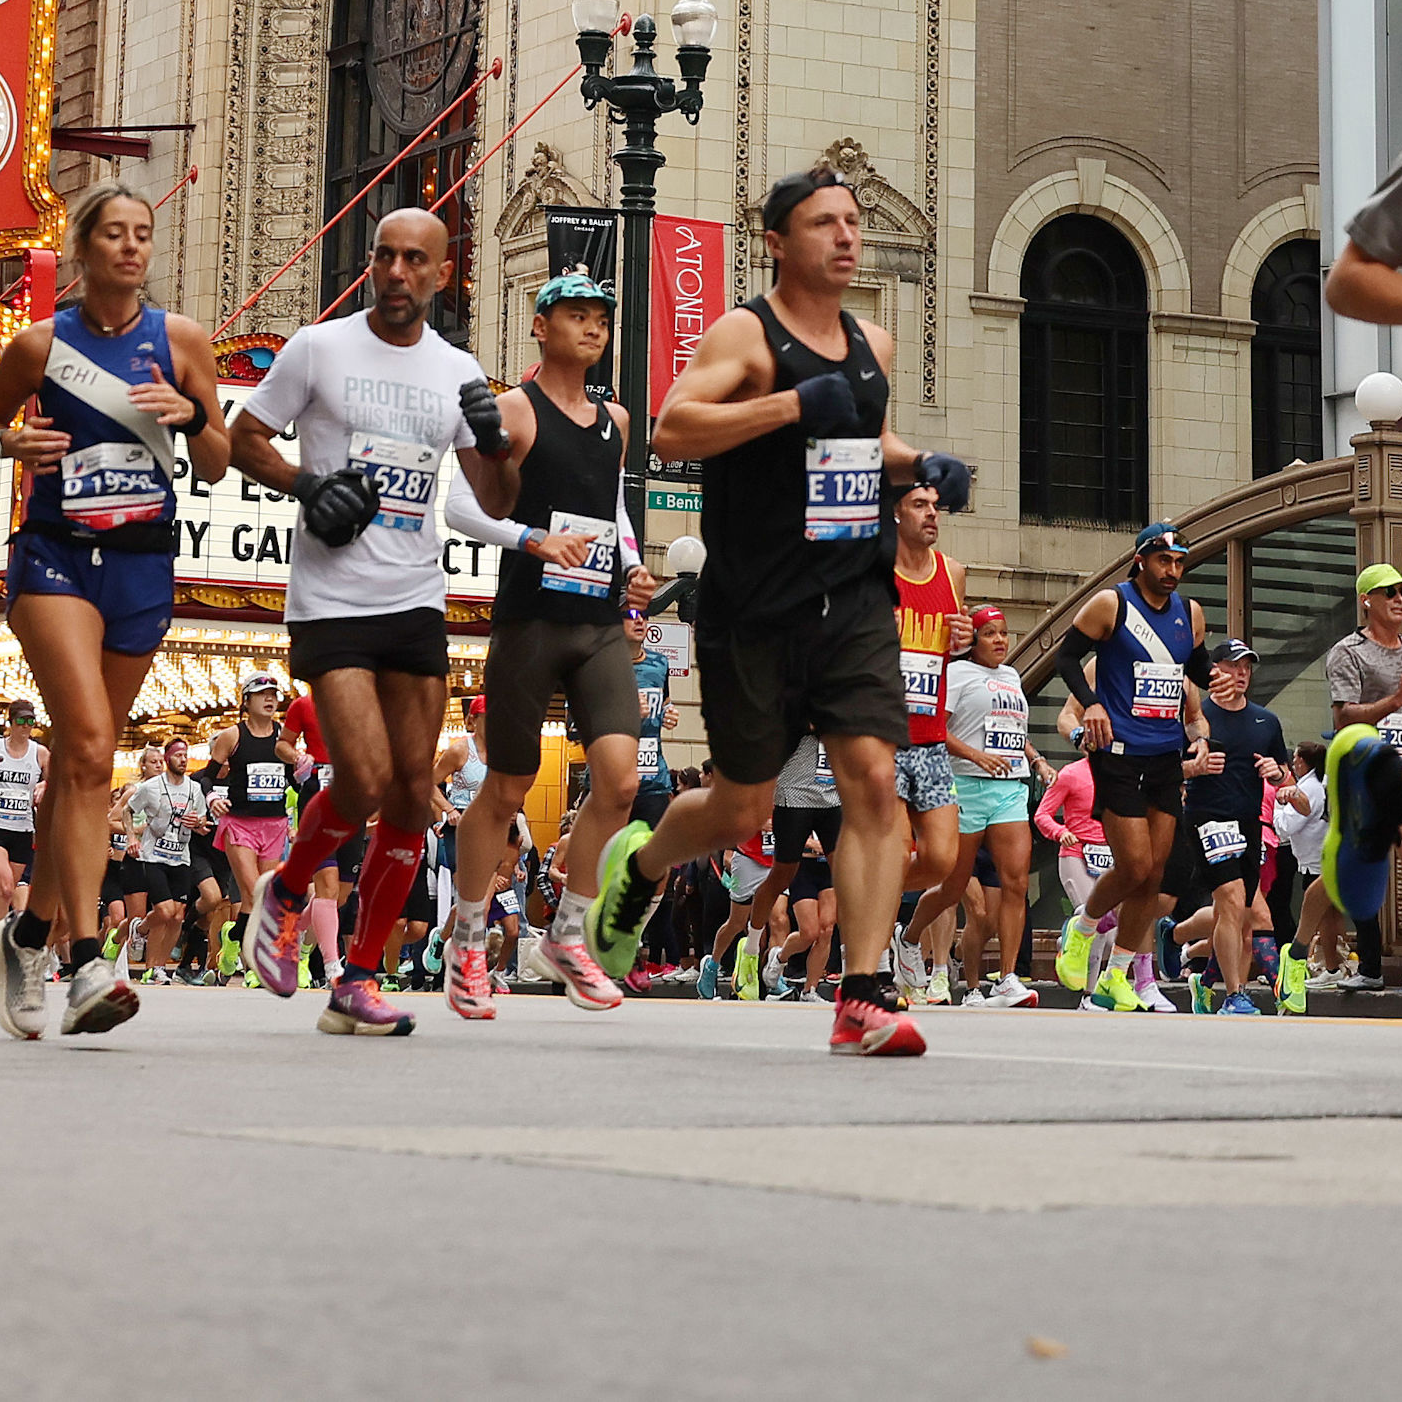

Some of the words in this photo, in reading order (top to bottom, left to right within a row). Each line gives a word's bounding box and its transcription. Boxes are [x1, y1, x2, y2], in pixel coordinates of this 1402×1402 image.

[551, 216, 579, 225] JOFFREY
[60, 364, 98, 386] CHI
[344, 375, 444, 417] PROTECT
[343, 405, 385, 431] THIS
[388, 411, 445, 440] HOUSE
[64, 479, 84, 497] D
[809, 473, 825, 502] E
[656, 496, 662, 506] E
[1134, 624, 1155, 642] CHI
[1136, 681, 1145, 695] F
[1148, 679, 1182, 698] 25027
[986, 734, 994, 747] E
[998, 733, 1025, 749] 10651
[1378, 730, 1386, 744] E
[818, 755, 826, 767] E
[249, 775, 256, 787] E
[259, 775, 285, 788] 8278
[113, 834, 119, 842] E
[763, 835, 769, 844] E
[1202, 839, 1211, 850] E
